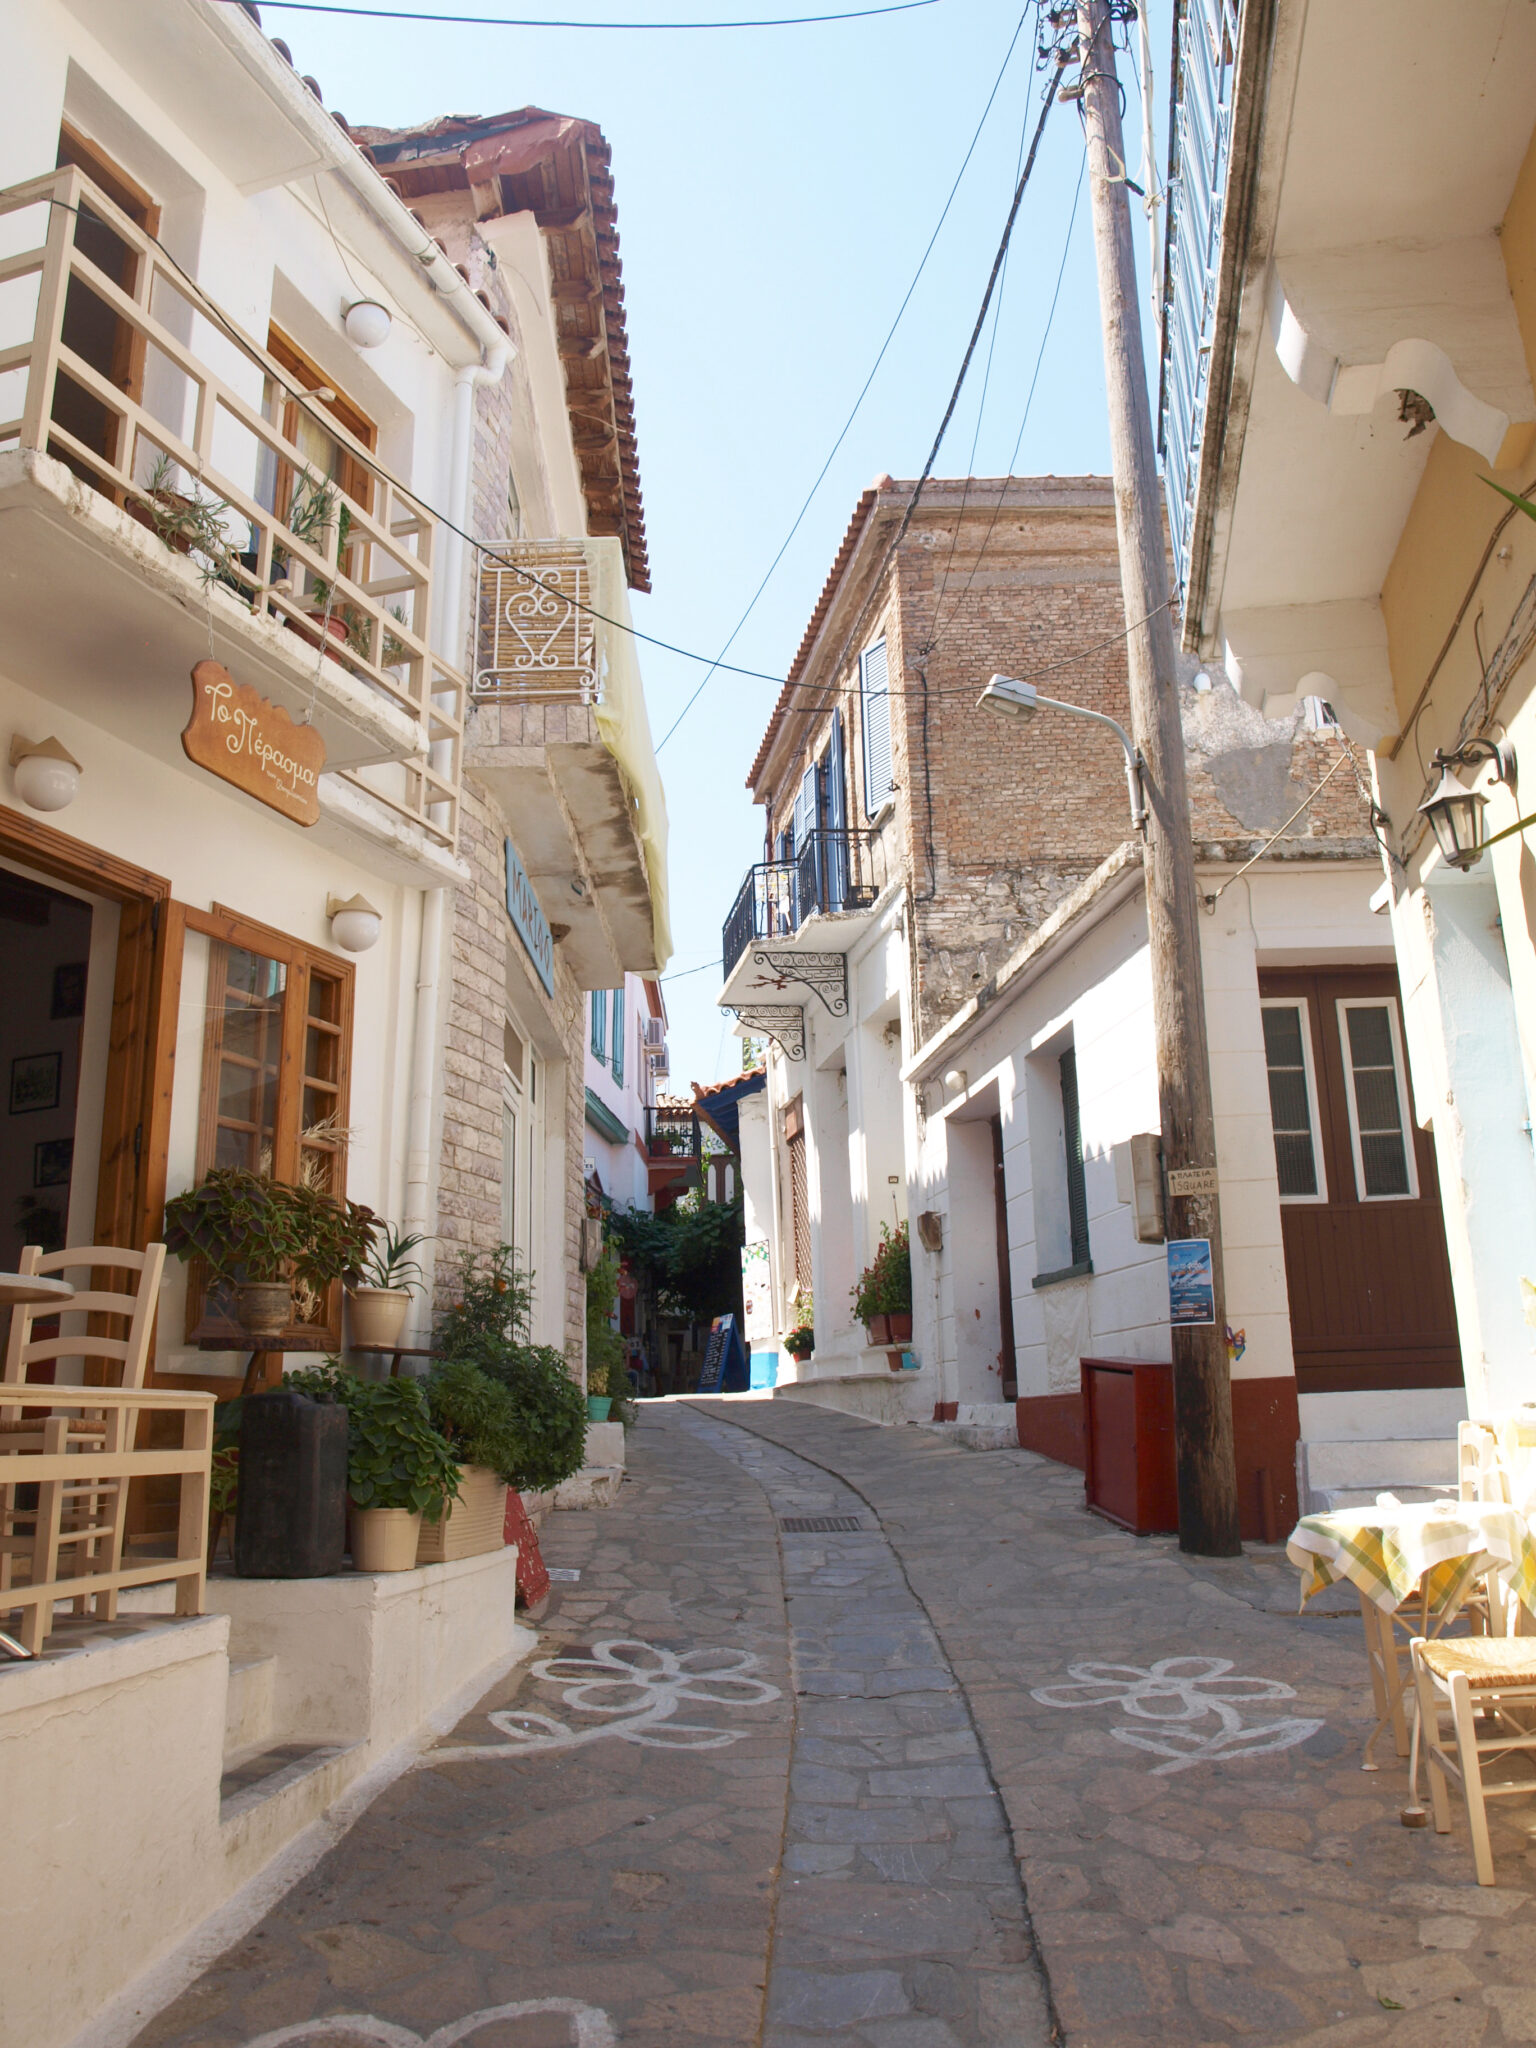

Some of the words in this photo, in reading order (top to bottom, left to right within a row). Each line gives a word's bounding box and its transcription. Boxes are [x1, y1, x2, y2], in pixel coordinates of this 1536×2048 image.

[204, 683, 232, 722] Το
[226, 709, 316, 789] Πέρασμα
[1177, 1180, 1216, 1191] SQUARE
